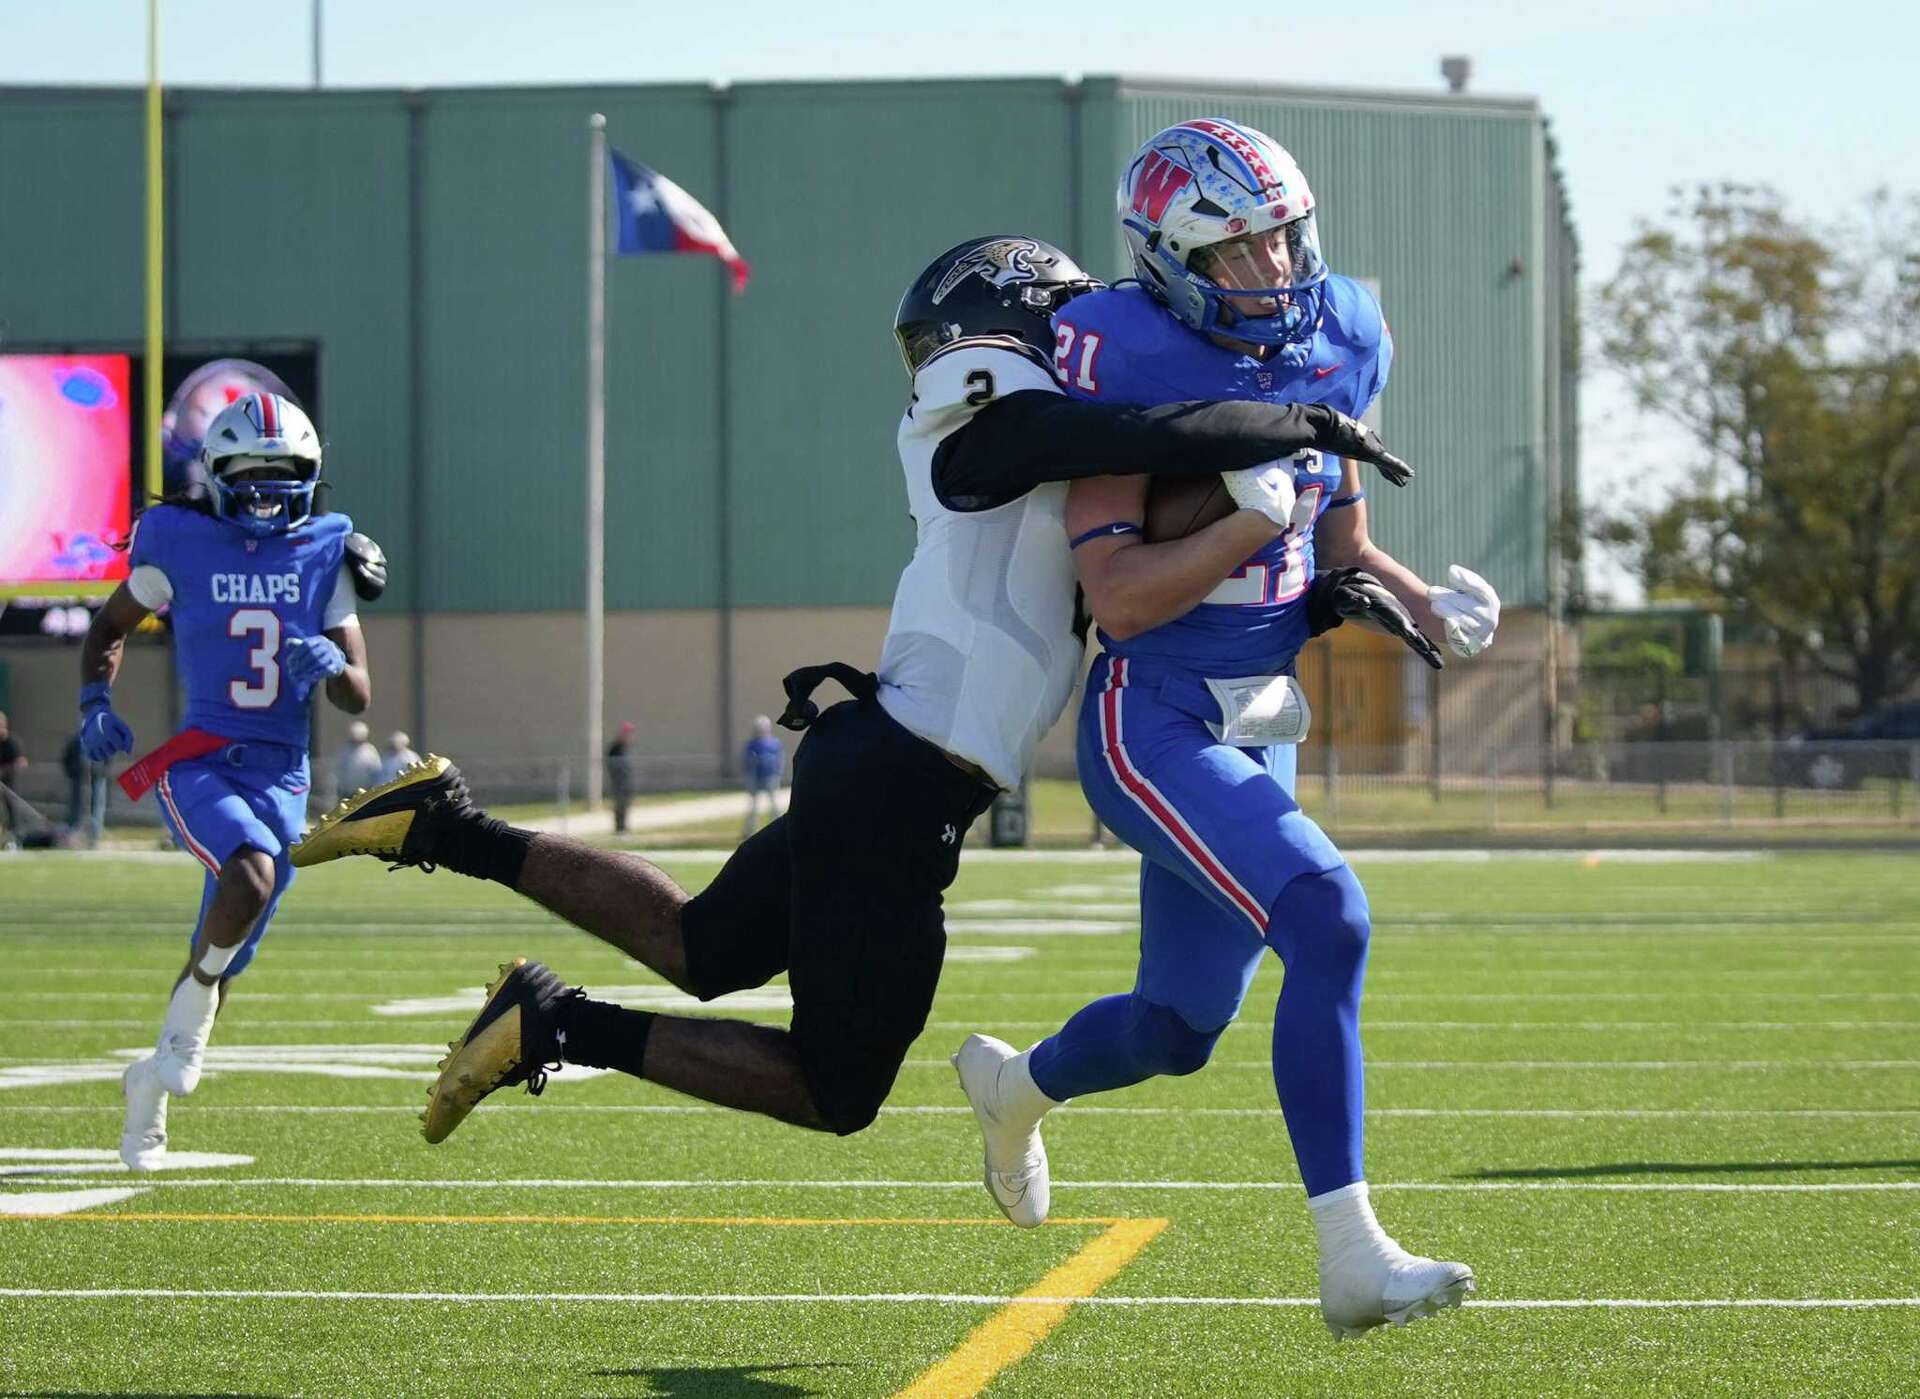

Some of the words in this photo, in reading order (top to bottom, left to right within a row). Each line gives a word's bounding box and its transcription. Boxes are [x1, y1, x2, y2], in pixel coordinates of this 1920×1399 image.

[1131, 148, 1196, 228] W
[1054, 322, 1102, 393] 21
[211, 573, 300, 604] CHAPS
[229, 609, 282, 709] 3
